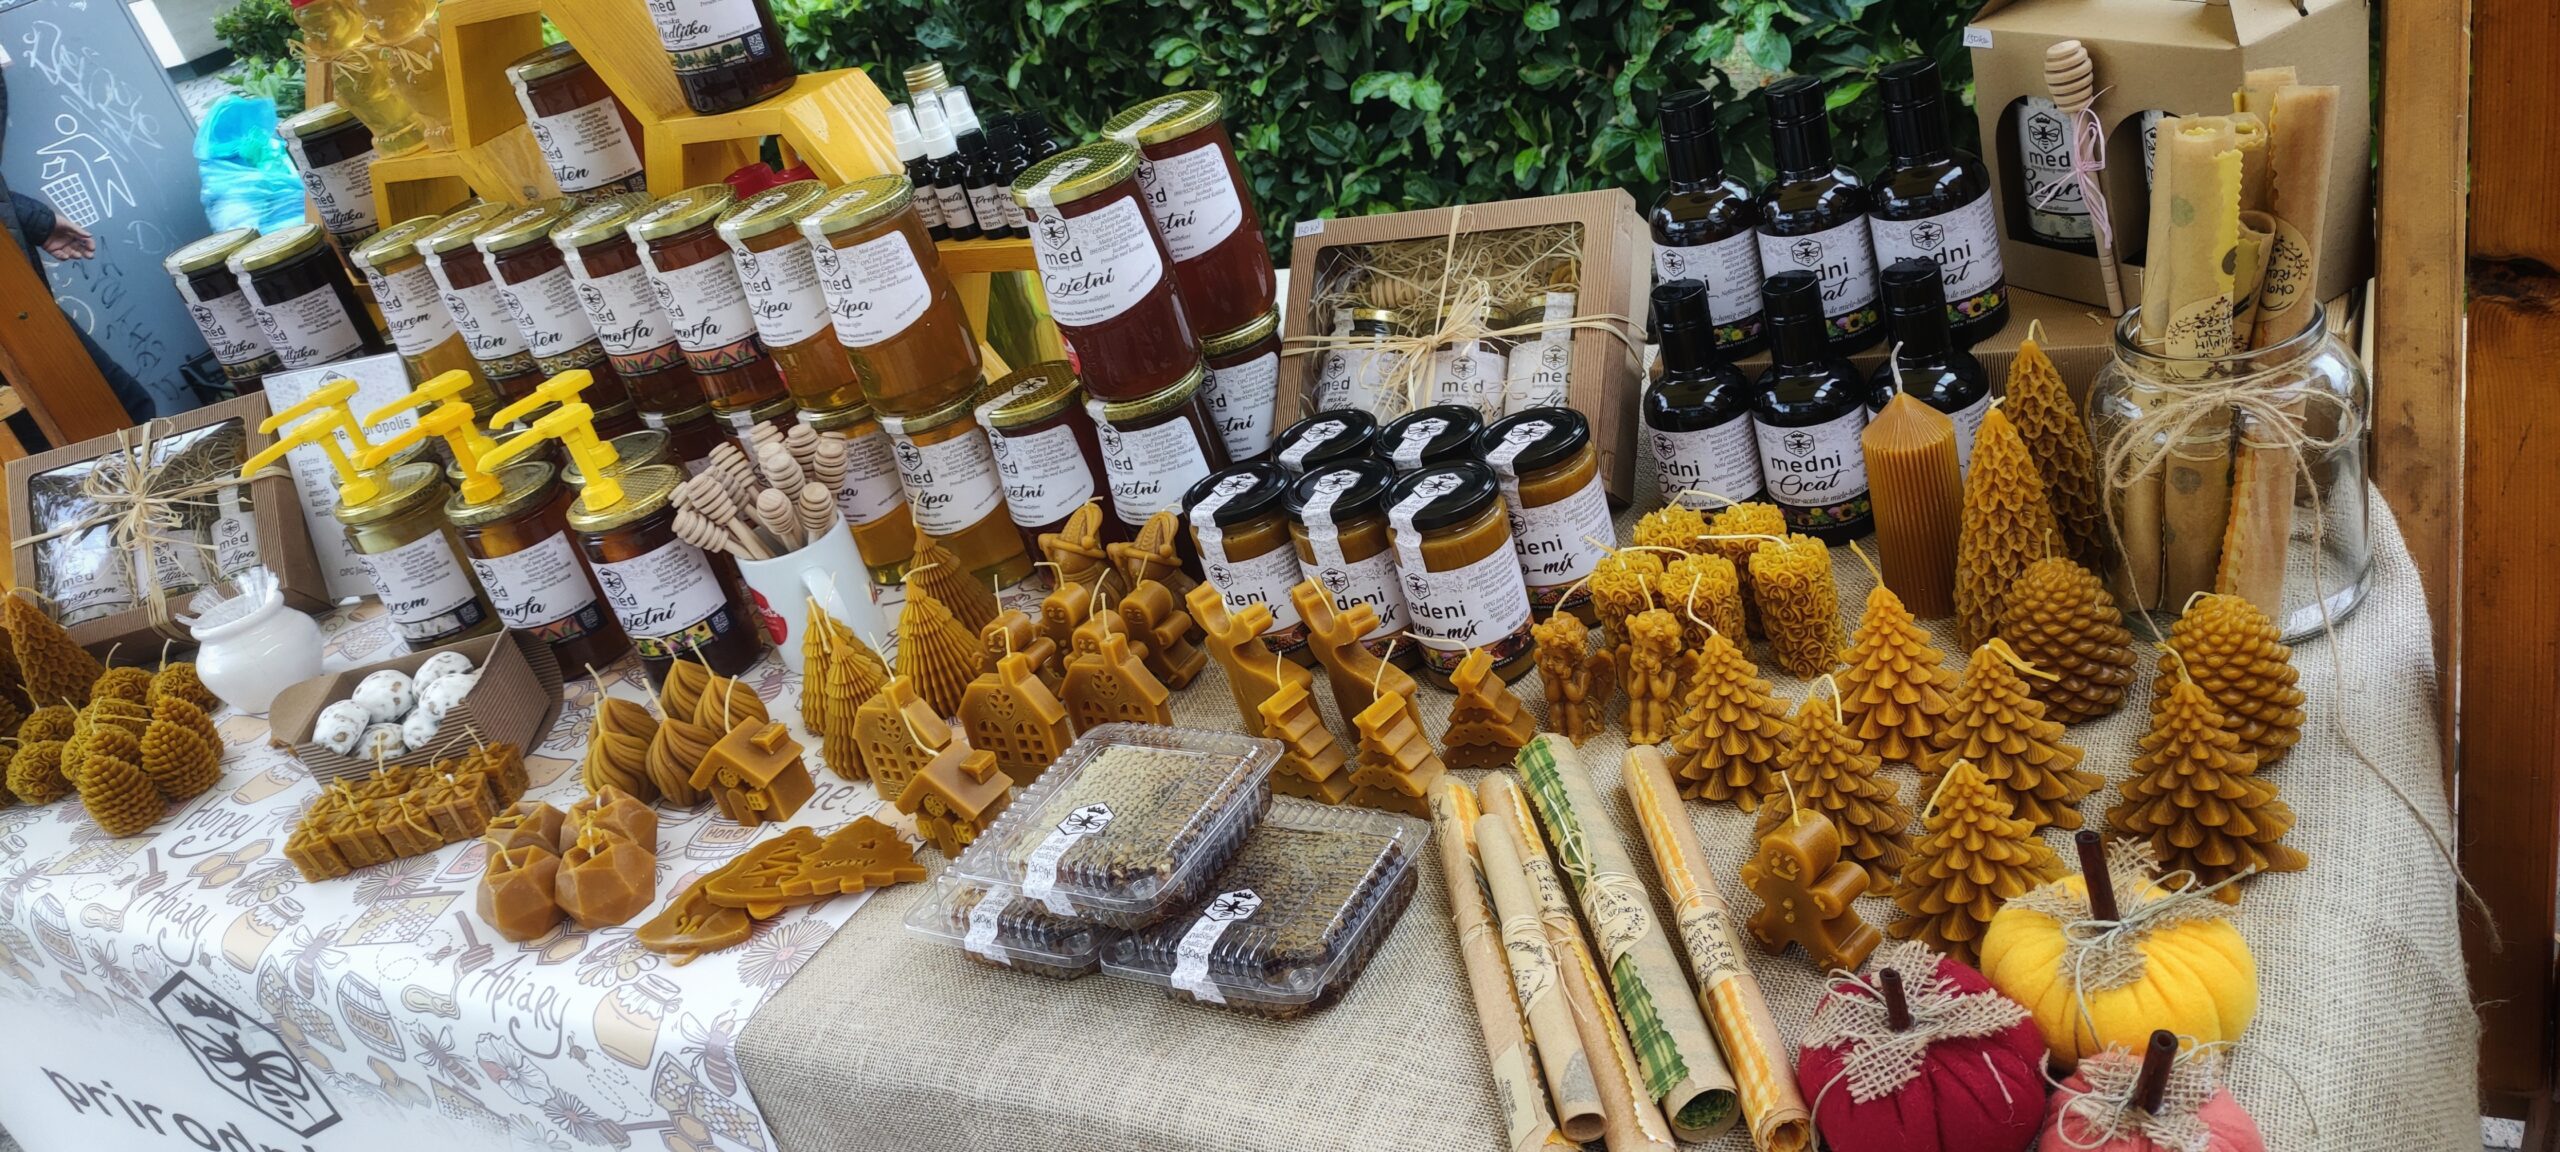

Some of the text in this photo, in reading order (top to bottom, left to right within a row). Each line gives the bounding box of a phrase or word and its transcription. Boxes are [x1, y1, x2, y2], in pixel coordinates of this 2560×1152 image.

[650, 0, 676, 13] med
[2029, 151, 2071, 167] med
[2023, 165, 2084, 203] Bagr
[1147, 187, 1167, 204] ed
[1159, 210, 1197, 234] etni
[1045, 246, 1083, 267] med
[744, 275, 772, 291] med
[823, 275, 853, 291] med
[751, 298, 793, 320] Lipa
[828, 297, 873, 320] Lipa
[525, 331, 564, 353] sten
[674, 316, 722, 347] morfa
[465, 332, 507, 354] sten
[1208, 394, 1226, 408] ed
[1524, 389, 1569, 408] Lip
[1217, 415, 1254, 436] etni
[1771, 449, 1842, 473] medni
[903, 470, 934, 484] med
[1770, 468, 1850, 496] Ocat
[1111, 480, 1162, 499] vjetni
[219, 532, 249, 549] med
[1516, 534, 1563, 555] deni
[387, 597, 429, 616] grem
[1225, 587, 1268, 606] deni
[1337, 587, 1385, 611] deni
[493, 596, 546, 623] morfa
[622, 602, 677, 631] vjetni
[1413, 619, 1484, 642] uno-mix
[168, 795, 270, 859] Honey
[468, 953, 572, 1061] Apiary
[349, 1006, 391, 1038] Honey
[41, 1065, 315, 1152] prirod
